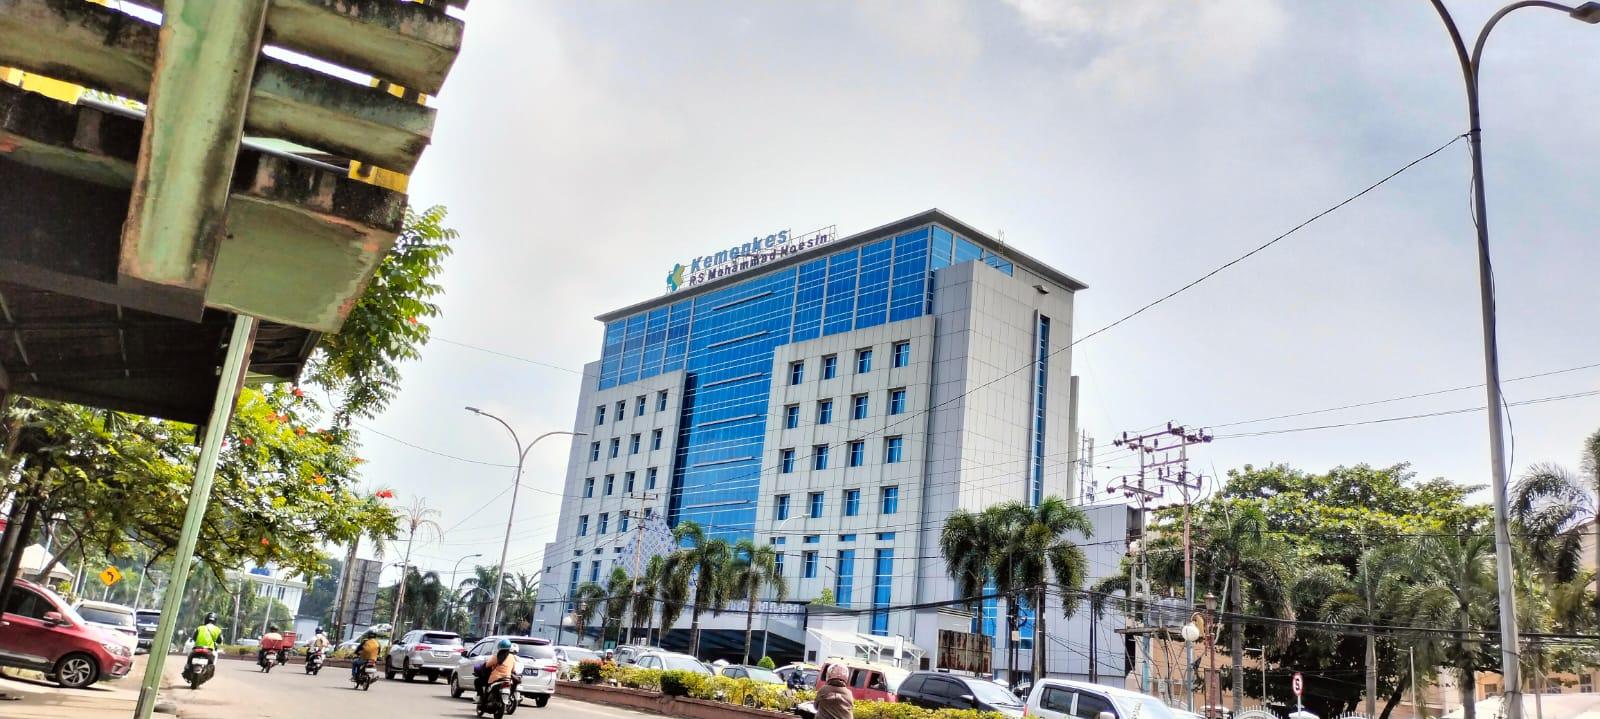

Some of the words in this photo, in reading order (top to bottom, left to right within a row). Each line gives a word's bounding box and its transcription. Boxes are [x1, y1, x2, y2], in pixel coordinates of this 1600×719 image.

[689, 272, 705, 286] RS
[708, 250, 776, 280] Mohammad
[780, 233, 828, 257] Hoesin
[690, 229, 788, 273] Kemenkes
